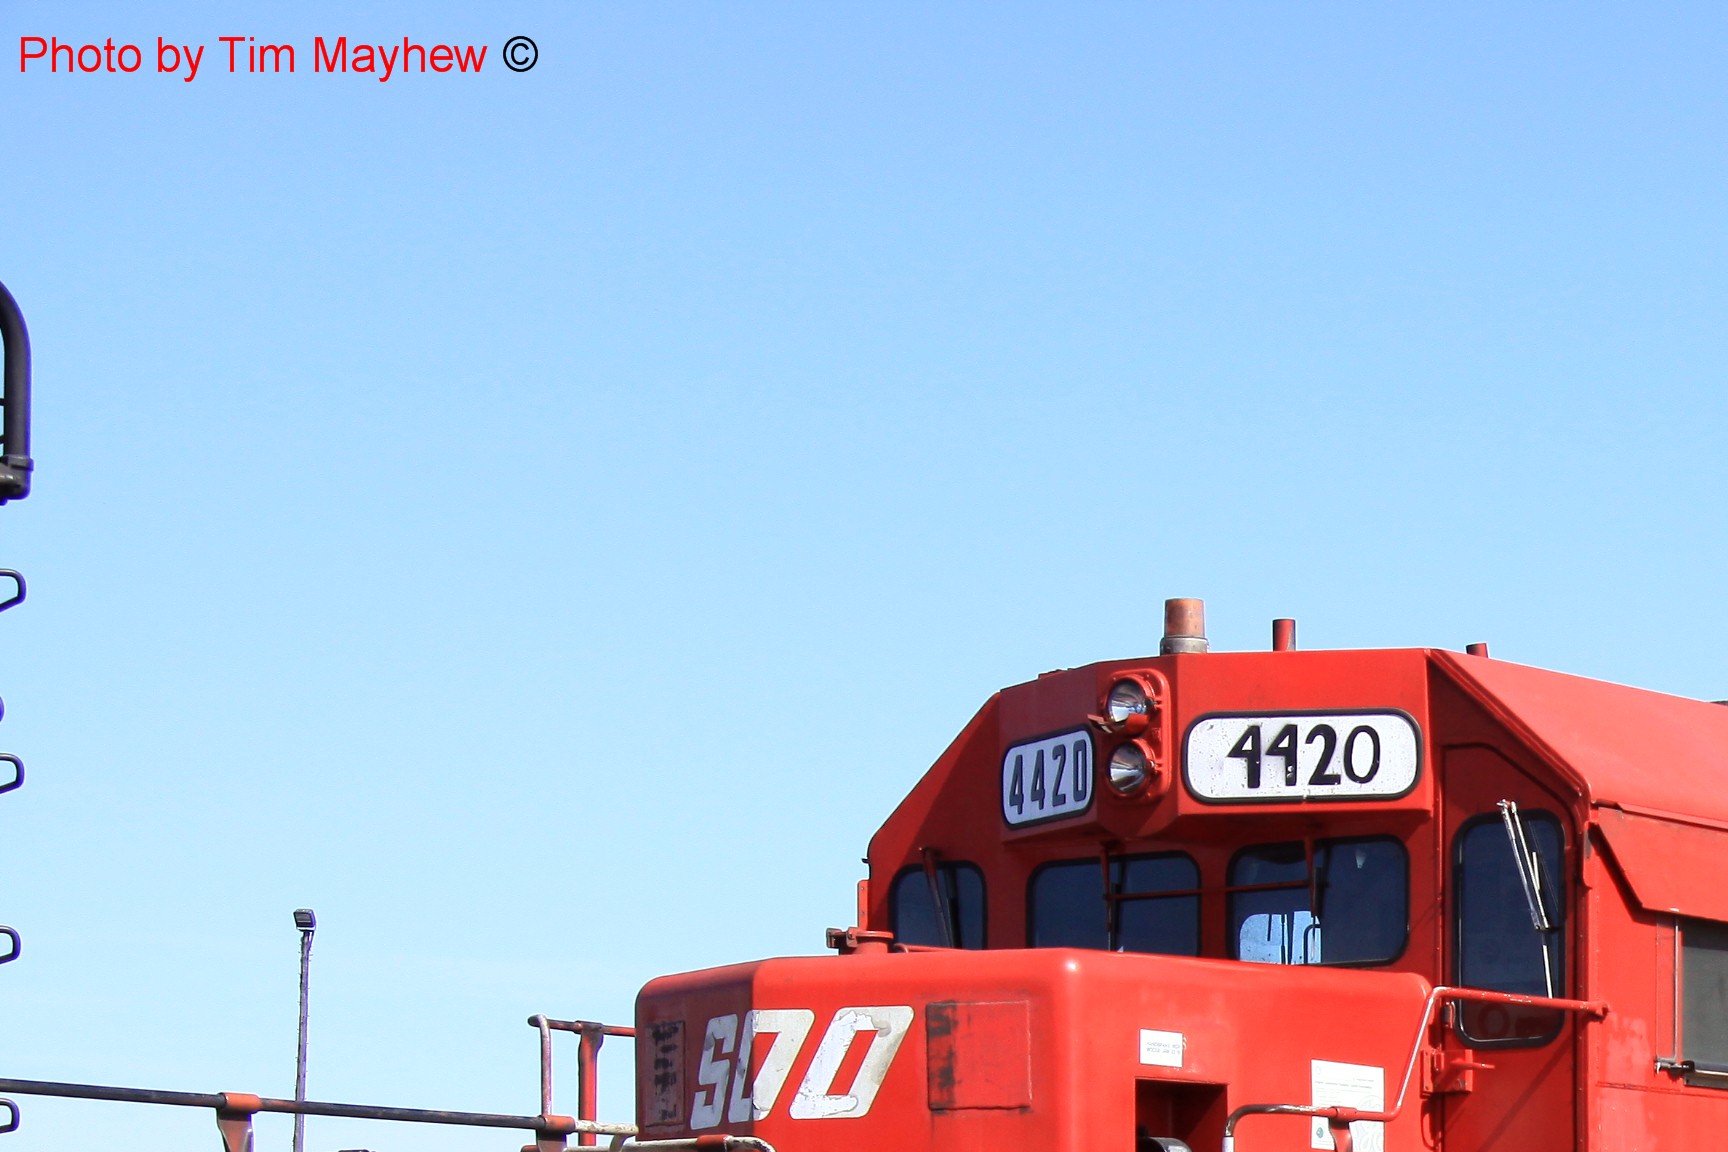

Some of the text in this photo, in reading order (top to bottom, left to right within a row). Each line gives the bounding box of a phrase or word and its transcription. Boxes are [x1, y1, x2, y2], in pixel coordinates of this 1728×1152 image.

[1009, 739, 1087, 815] 4420
[1226, 724, 1381, 788] 4420
[690, 1005, 915, 1130] SOO
